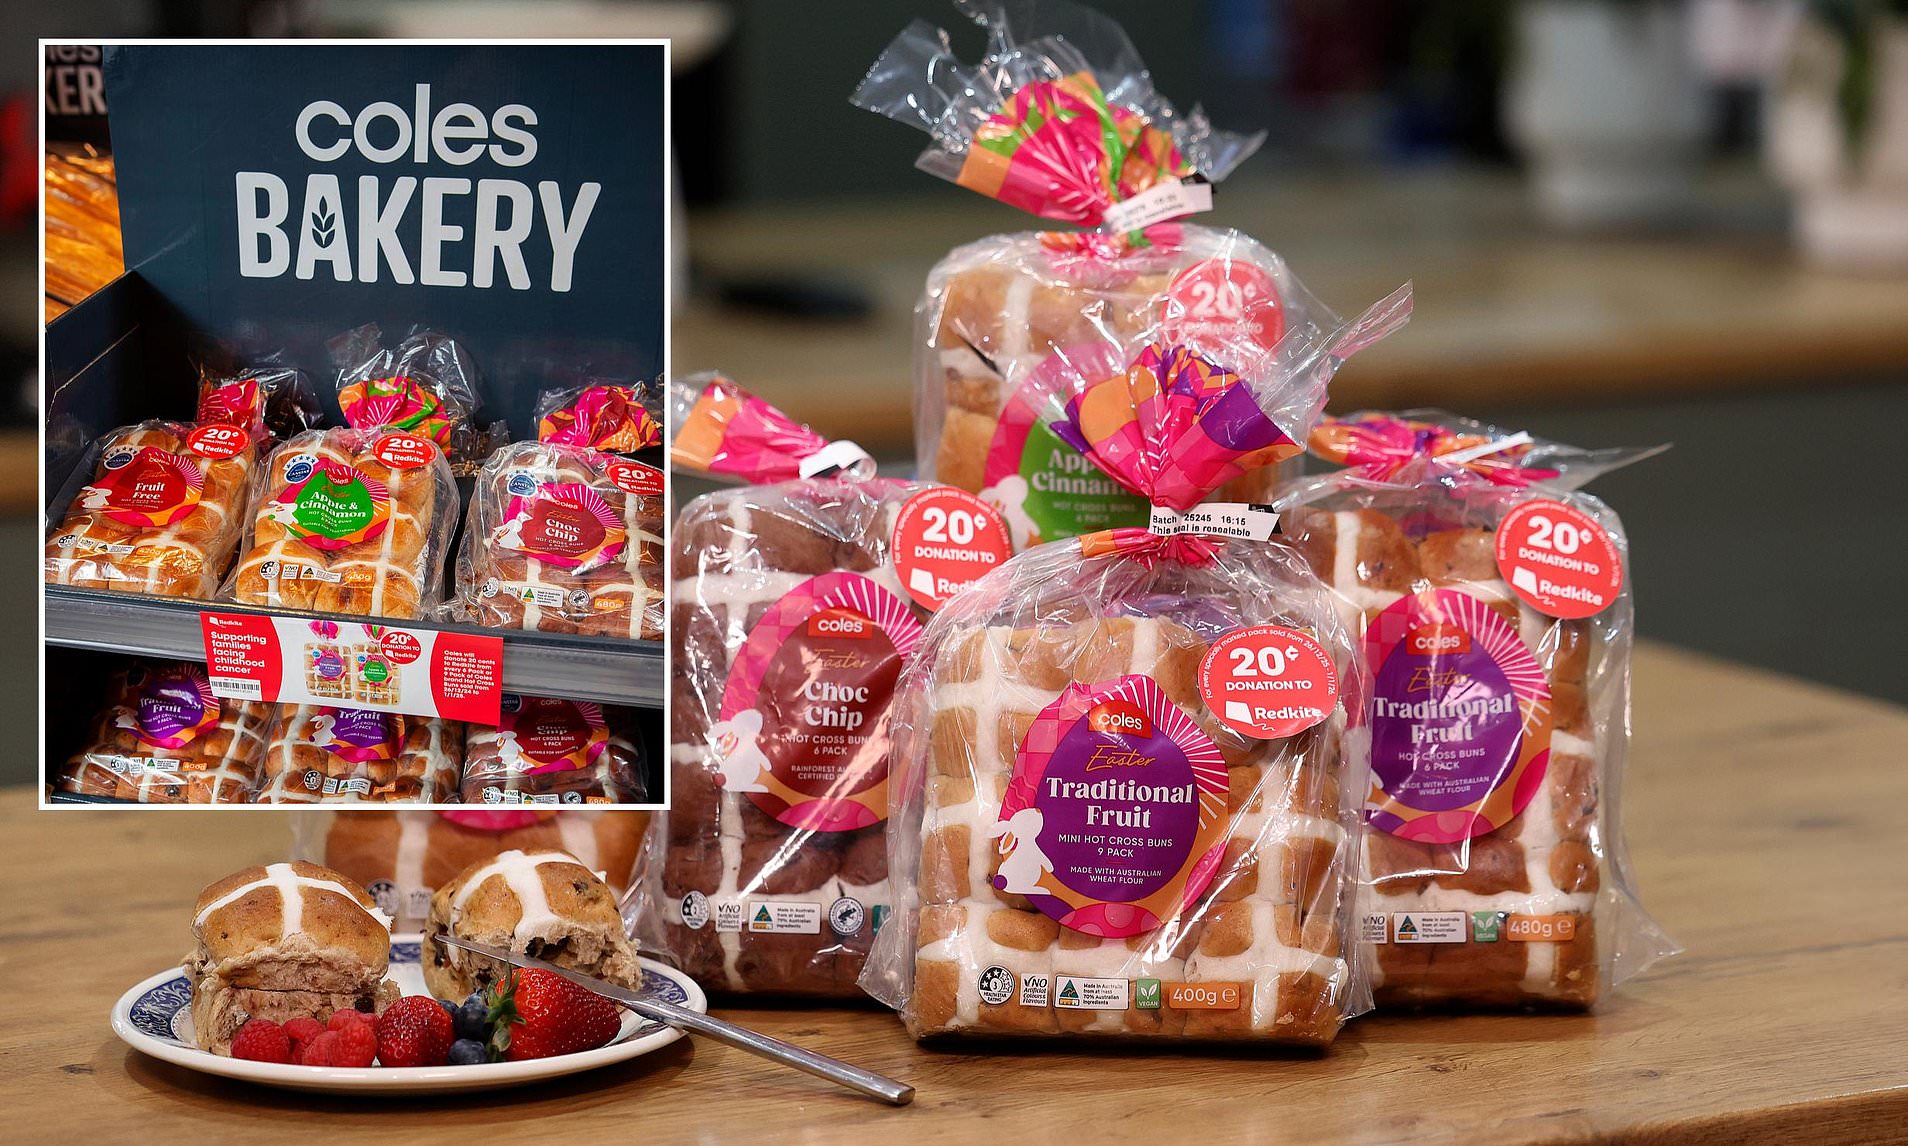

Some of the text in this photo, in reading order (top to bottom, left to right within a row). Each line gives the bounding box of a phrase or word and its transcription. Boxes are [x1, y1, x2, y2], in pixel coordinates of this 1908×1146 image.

[295, 83, 538, 168] coles
[235, 171, 602, 292] BAKERY
[205, 445, 234, 455] Redkite
[394, 454, 425, 464] Redkite
[1048, 449, 1094, 474] App
[135, 482, 166, 491] Fruit
[1032, 471, 1127, 496] Cinnam
[132, 492, 161, 500] Free
[310, 491, 358, 510] Apple &
[300, 500, 367, 518] Cinnamon
[545, 518, 581, 534] Choc
[1152, 513, 1246, 526] Batch 25245 16:15
[545, 529, 578, 543] Chip
[1152, 525, 1171, 535] This
[1173, 524, 1189, 533] seal
[1192, 524, 1200, 532] is
[914, 545, 996, 564] DONATION TO
[1518, 547, 1600, 575] DONATION TO
[1539, 579, 1604, 606] Redkite
[818, 617, 863, 633] coles
[210, 631, 267, 645] Supporting
[1221, 631, 1247, 647] marked
[1247, 629, 1268, 637] pack
[1269, 629, 1285, 637] sold
[1286, 632, 1304, 644] from
[211, 640, 251, 650] families
[1415, 634, 1460, 649] coles
[213, 648, 245, 659] facing
[1204, 644, 1223, 670] specially
[214, 657, 265, 667] childhood
[215, 665, 251, 674] cancer
[1203, 670, 1211, 688] every
[1225, 680, 1312, 691] DONATION TO
[804, 681, 869, 703] Choc
[153, 704, 181, 713] Fruit
[1254, 706, 1322, 720] Redkite
[1373, 693, 1513, 719] Traditional
[804, 705, 864, 731] Chip
[1099, 712, 1142, 730] coles
[1411, 721, 1474, 744] Fruit
[812, 735, 845, 744] CROSS
[847, 735, 871, 745] BUN
[814, 746, 848, 755] 6 PACK
[1422, 751, 1456, 761] CROSS
[1459, 748, 1486, 758] BUNS
[1085, 744, 1156, 772] Easter
[791, 765, 835, 773] RAINFOREST
[1433, 762, 1460, 771] PACK
[798, 772, 835, 780] CERTIFIED
[1444, 776, 1490, 787] AUSTRALIAN
[1046, 777, 1194, 804] Traditional
[1086, 805, 1152, 828] Fruit
[1058, 834, 1173, 847] MINI HOT CROSS BUNS
[1097, 847, 1134, 858] 9 PACK
[1070, 866, 1162, 877] MADE WITH AUSTRALIAN
[1089, 875, 1144, 885] WHEAT FLOUR
[1510, 920, 1553, 937] 480g
[993, 981, 998, 990] 3
[1173, 988, 1217, 1005] 400g
